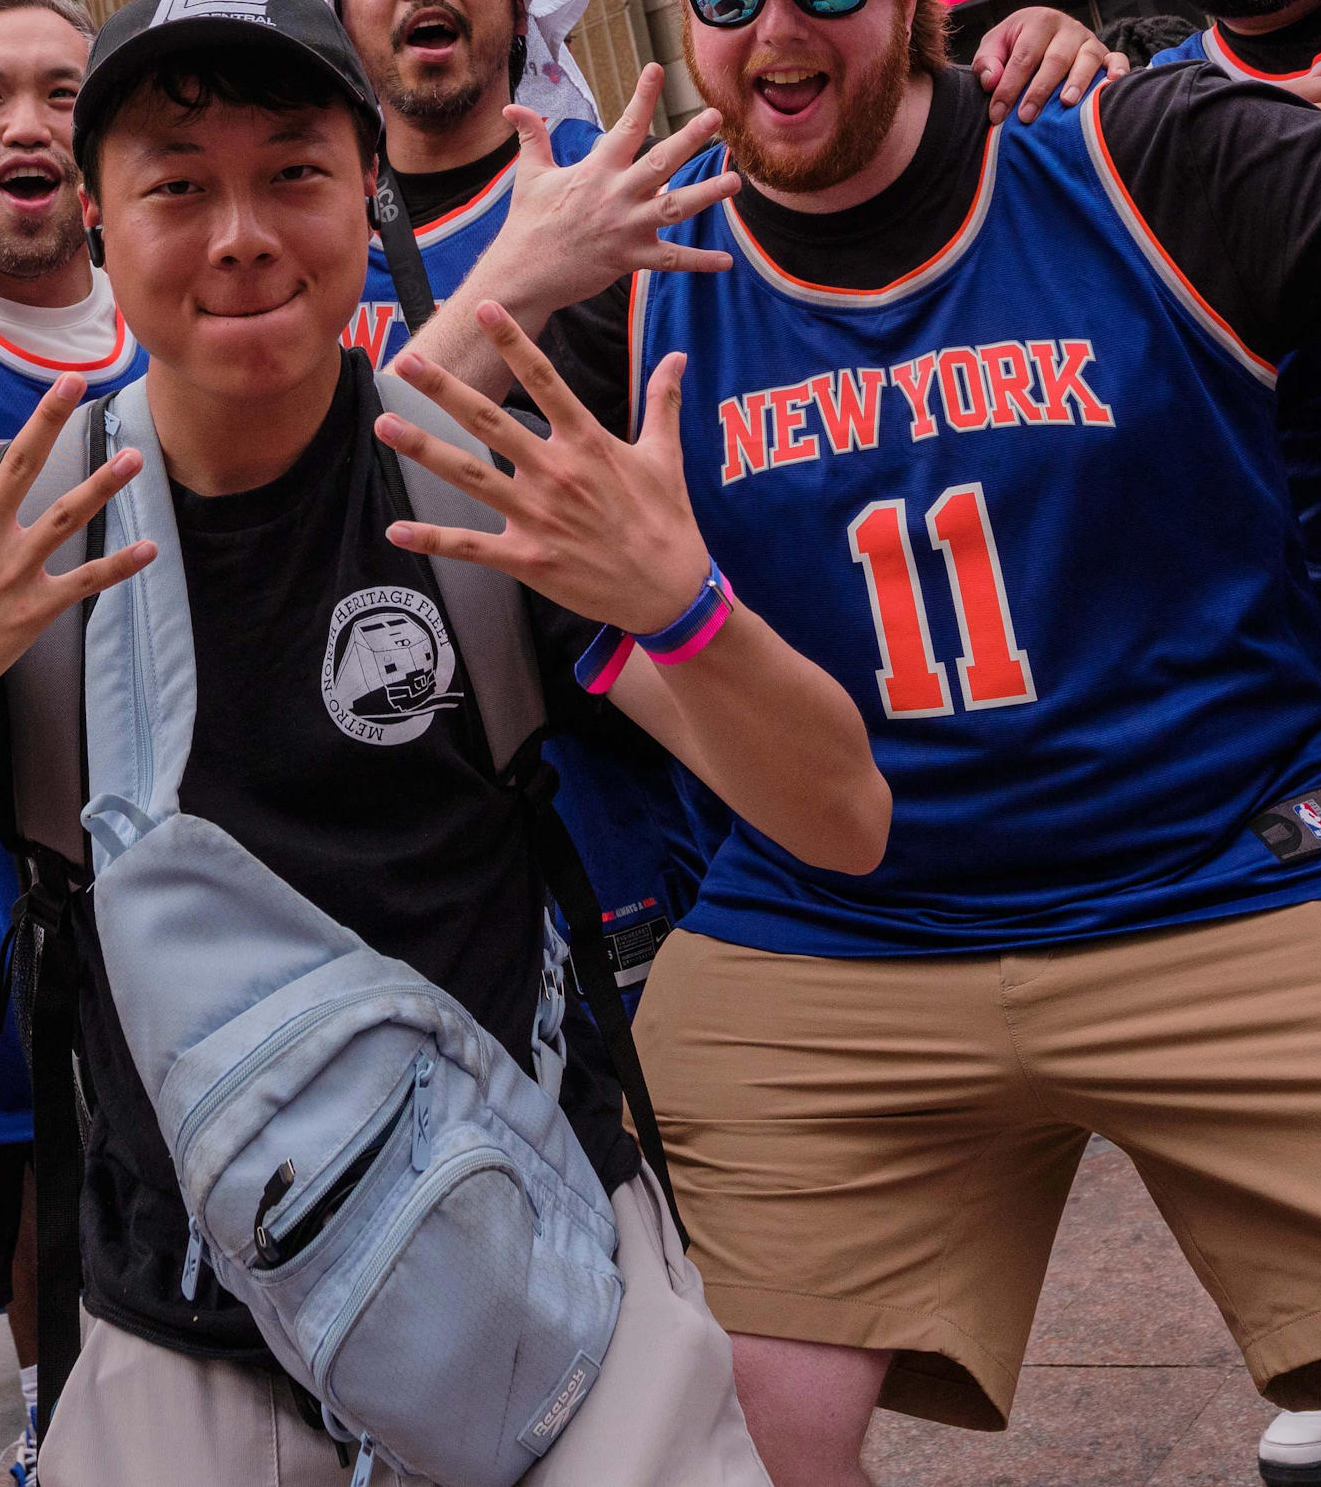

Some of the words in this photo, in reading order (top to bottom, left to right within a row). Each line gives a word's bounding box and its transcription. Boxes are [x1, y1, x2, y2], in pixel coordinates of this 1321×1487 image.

[718, 367, 886, 487] NEW
[889, 338, 1117, 443] YORK
[334, 590, 415, 625] HERITAGE
[415, 599, 451, 648] FLEET
[847, 481, 1039, 720] 11
[323, 626, 385, 742] METRO-NORTH
[533, 1369, 584, 1437] Reebok
